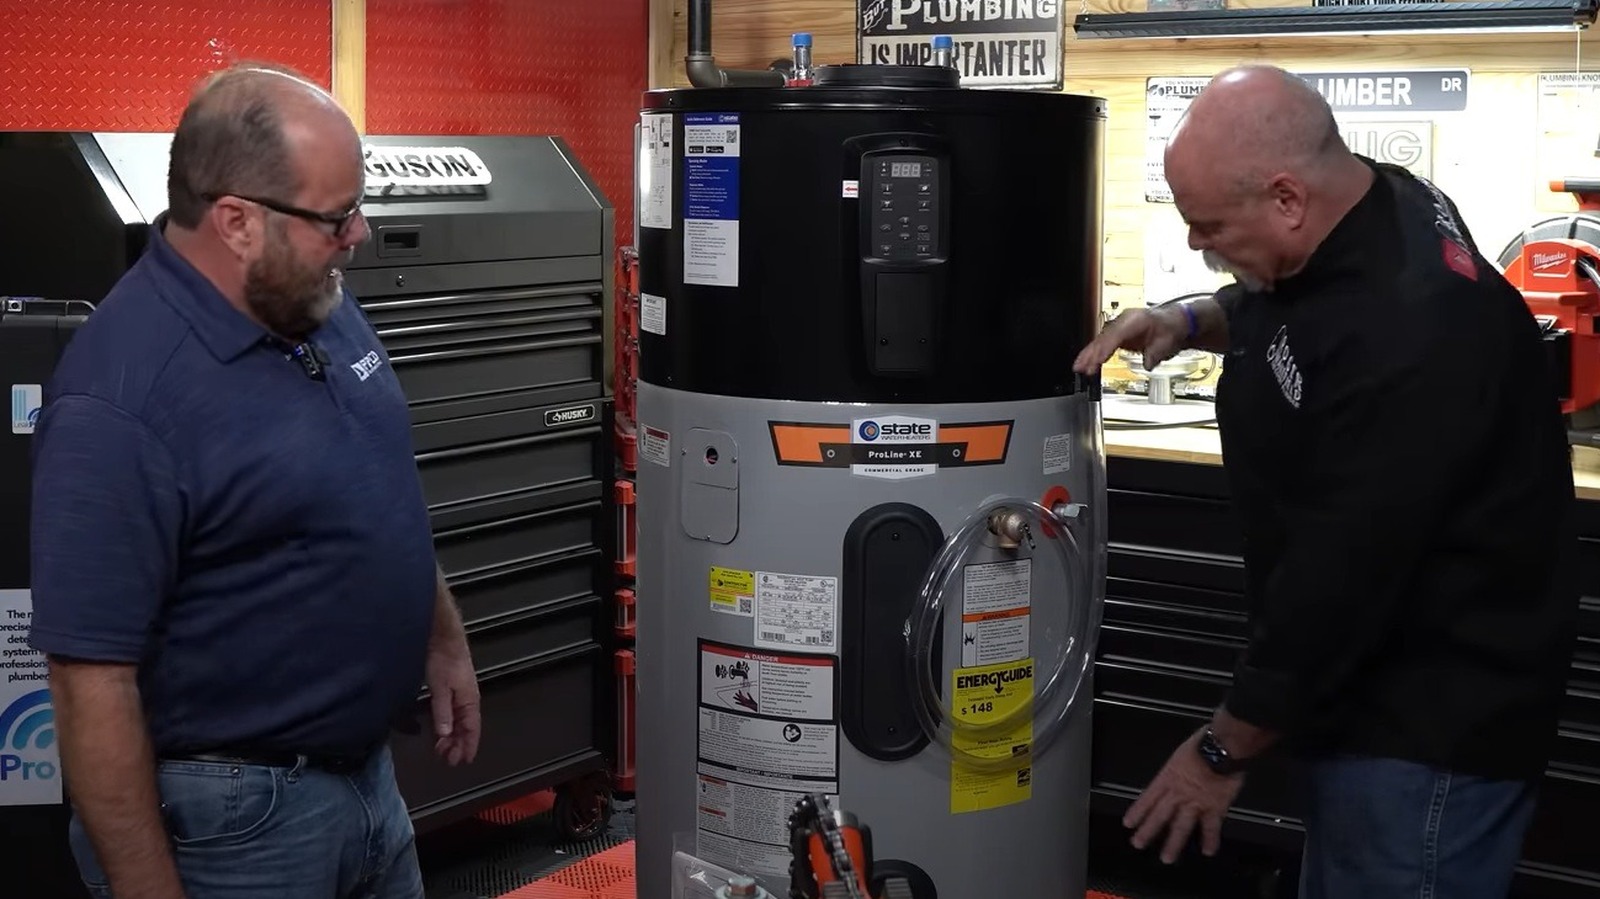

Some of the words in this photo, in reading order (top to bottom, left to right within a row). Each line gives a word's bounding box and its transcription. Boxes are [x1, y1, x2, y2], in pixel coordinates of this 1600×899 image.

[887, 0, 1057, 30] PLUMBING
[871, 43, 890, 65] IS
[896, 39, 1046, 77] IMPRTANTER
[1582, 74, 1600, 82] KNO
[1317, 77, 1412, 106] UMBER
[1441, 77, 1462, 92] DR
[1532, 251, 1567, 267] Milwaukee
[561, 409, 587, 421] HUSKY
[881, 423, 931, 435] state
[909, 450, 922, 459] XE
[6, 609, 26, 619] The
[3, 649, 39, 658] system
[751, 653, 779, 662] DANGER
[971, 703, 993, 715] 148
[1, 754, 56, 781] Pro
